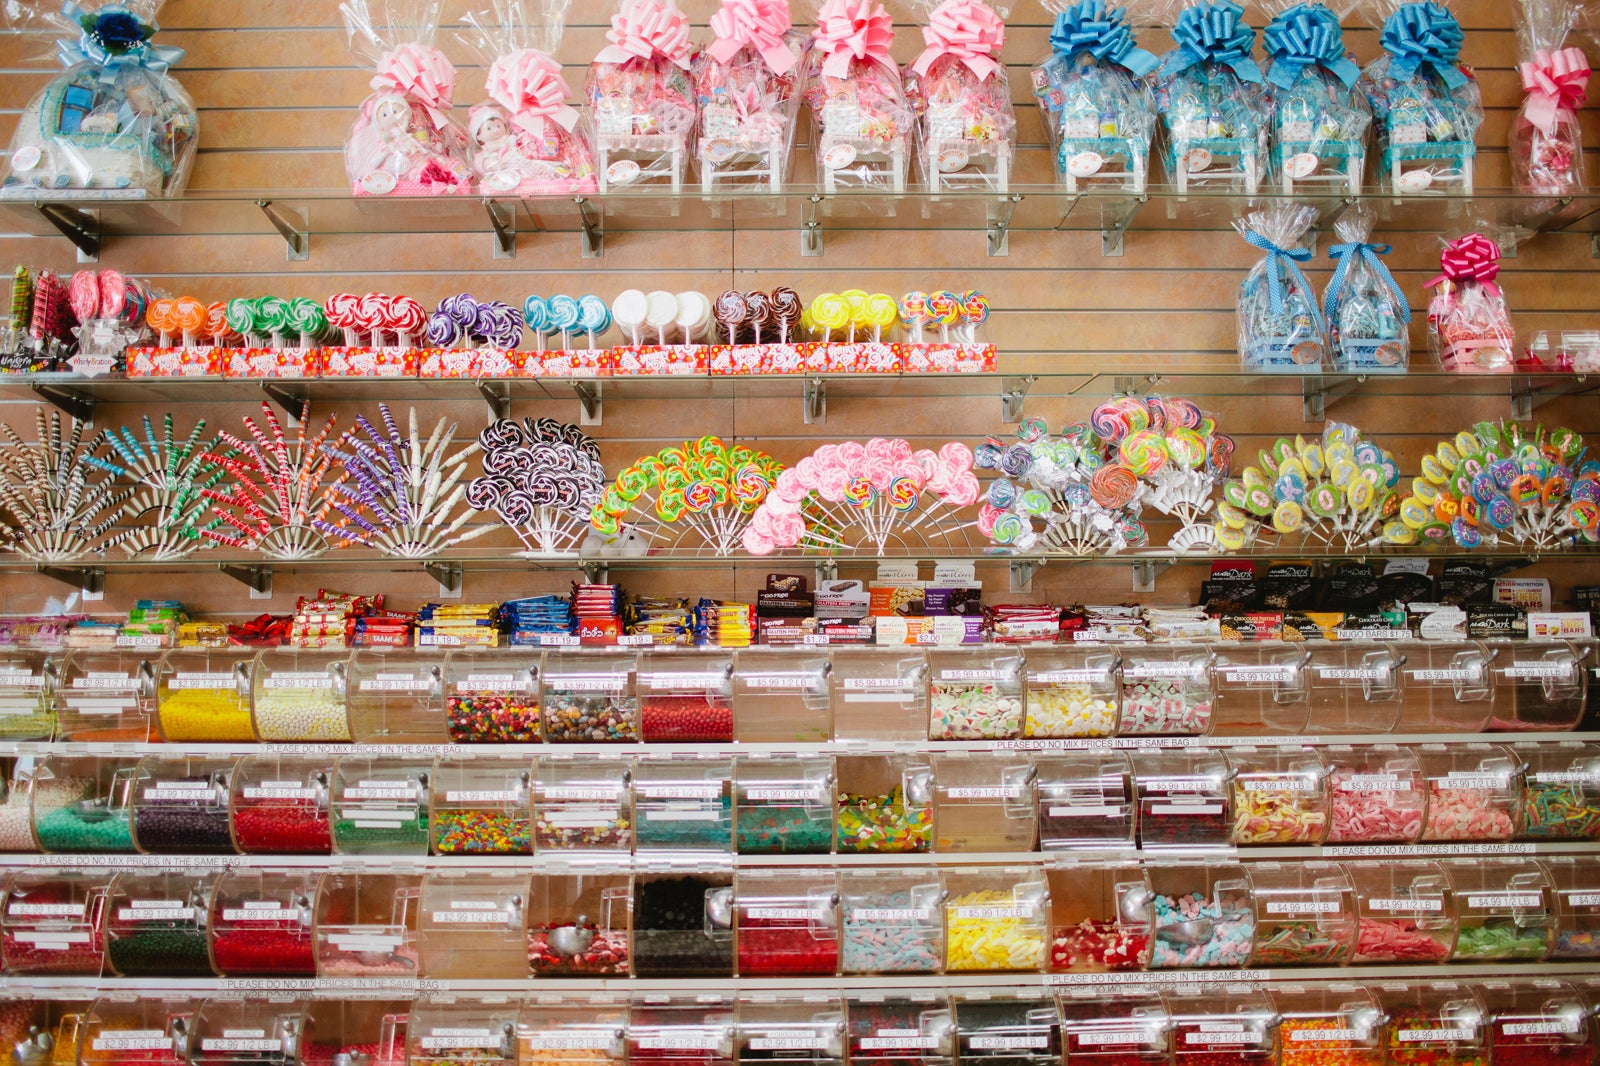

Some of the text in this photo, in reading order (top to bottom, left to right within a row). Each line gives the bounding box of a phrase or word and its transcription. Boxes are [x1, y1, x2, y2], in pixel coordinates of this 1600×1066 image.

[134, 637, 158, 645] EACH
[430, 636, 452, 644] $1.19
[550, 636, 571, 644] $1.19
[82, 679, 131, 688] $2.99 1/2 LB
[178, 680, 227, 688] $2.99 1/2 LB
[155, 790, 205, 798] $2.99 1/2 LB
[1479, 897, 1530, 906] $4.99 1/2 LB
[130, 909, 184, 918] $2.99 1/2 LB
[1197, 1034, 1251, 1042] $2.99 1/2 LB
[1409, 1030, 1463, 1039] $2.99 1/2 LB
[104, 1039, 162, 1048] $2.99 1/2 LB
[981, 1039, 1037, 1047] $2.99 1/2 LB
